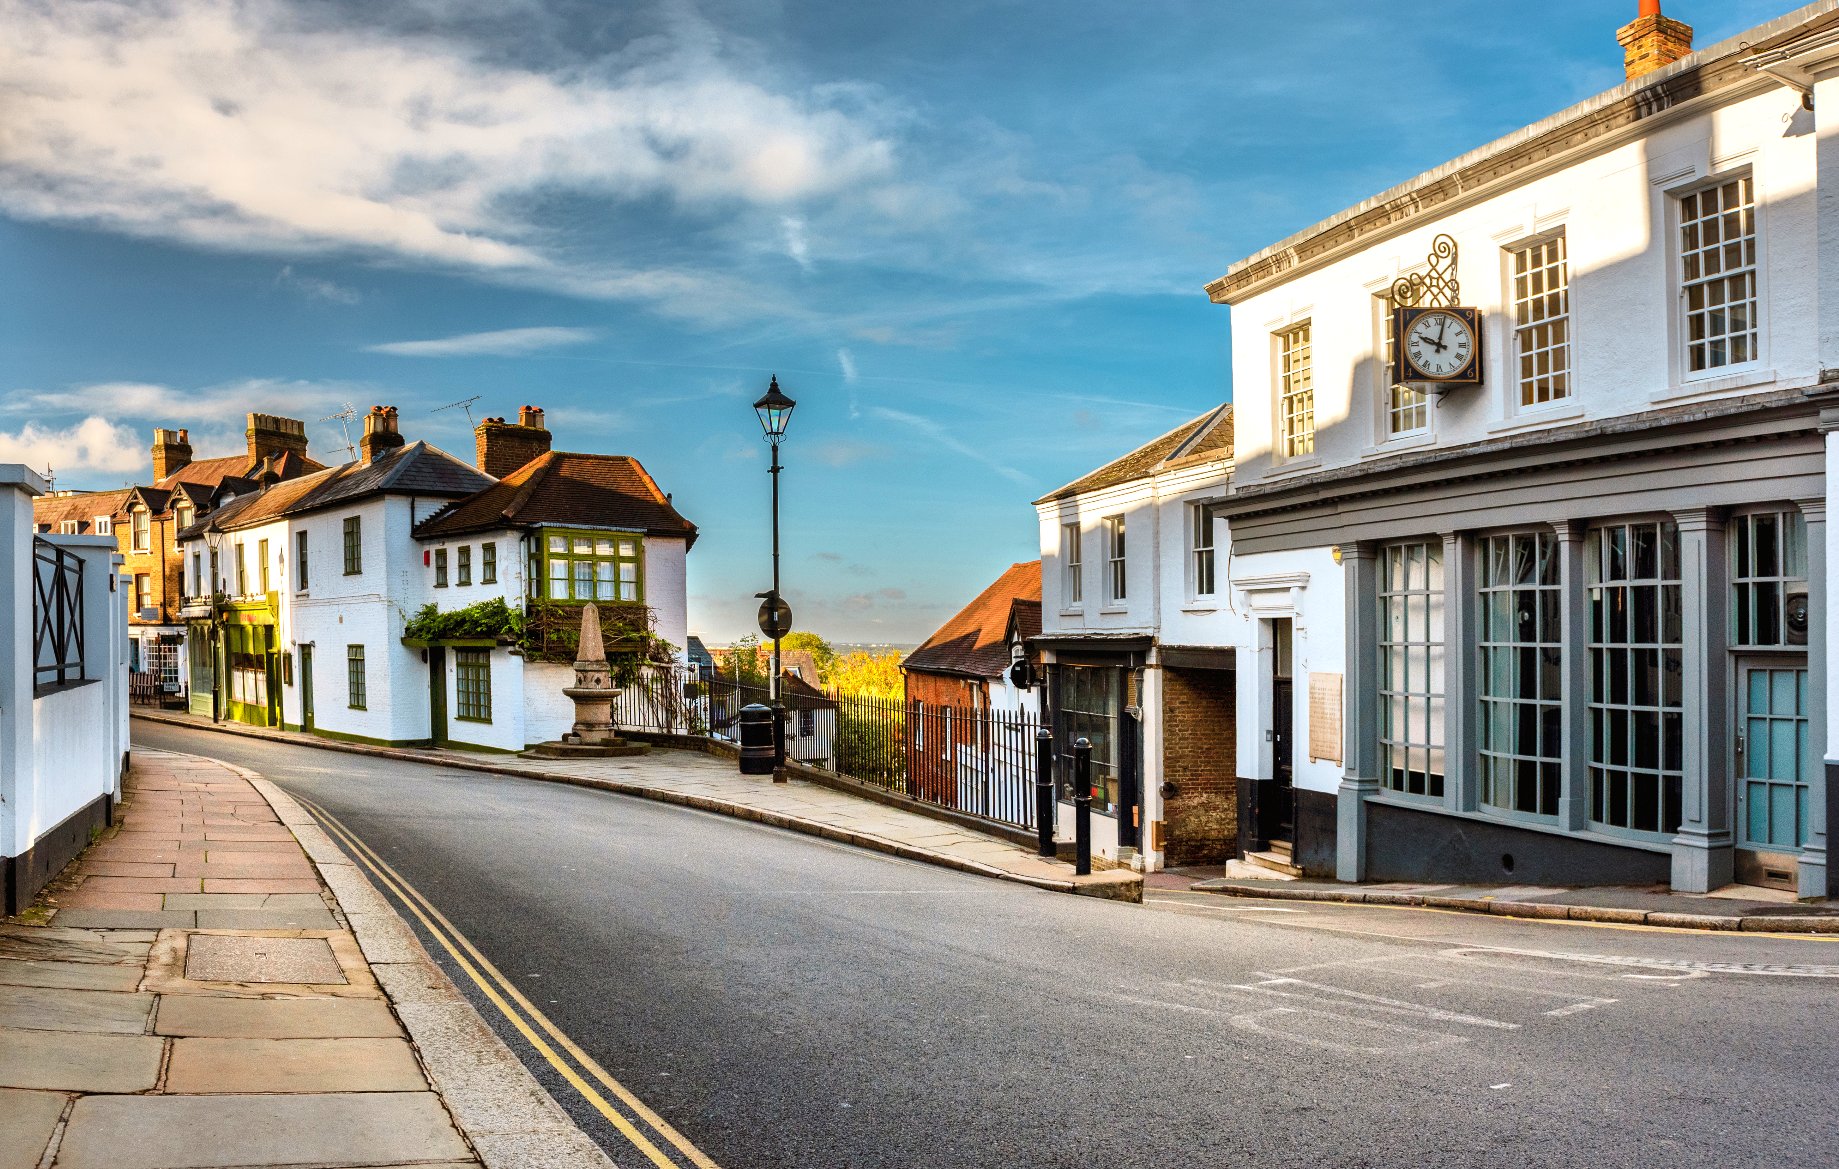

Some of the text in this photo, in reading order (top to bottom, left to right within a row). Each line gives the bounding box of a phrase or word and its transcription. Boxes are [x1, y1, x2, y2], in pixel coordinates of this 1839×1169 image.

[1466, 311, 1472, 320] 9
[1407, 368, 1412, 377] 4
[1467, 368, 1473, 377] 6
